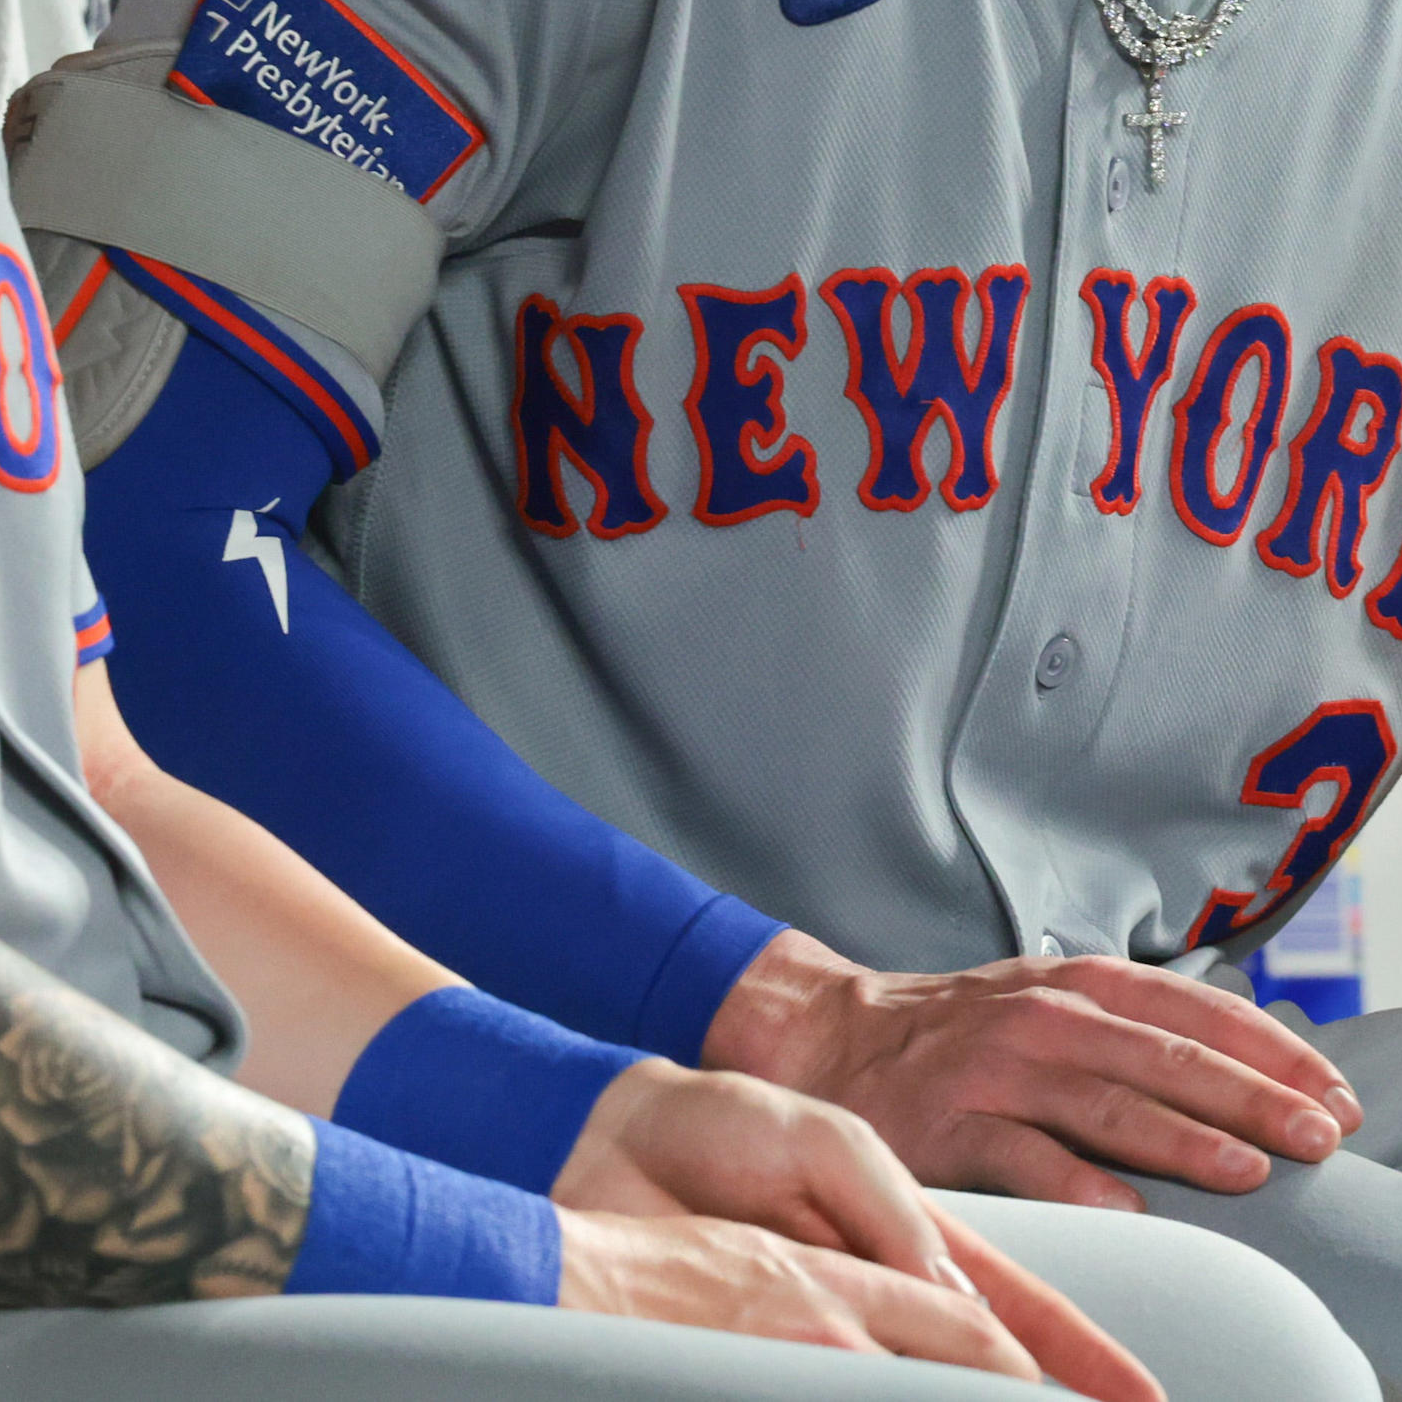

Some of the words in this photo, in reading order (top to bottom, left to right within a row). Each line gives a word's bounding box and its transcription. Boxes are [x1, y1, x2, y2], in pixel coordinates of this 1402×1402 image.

[251, 0, 395, 137] NewYork-
[512, 262, 1032, 542] NEW
[1184, 698, 1398, 955] 3
